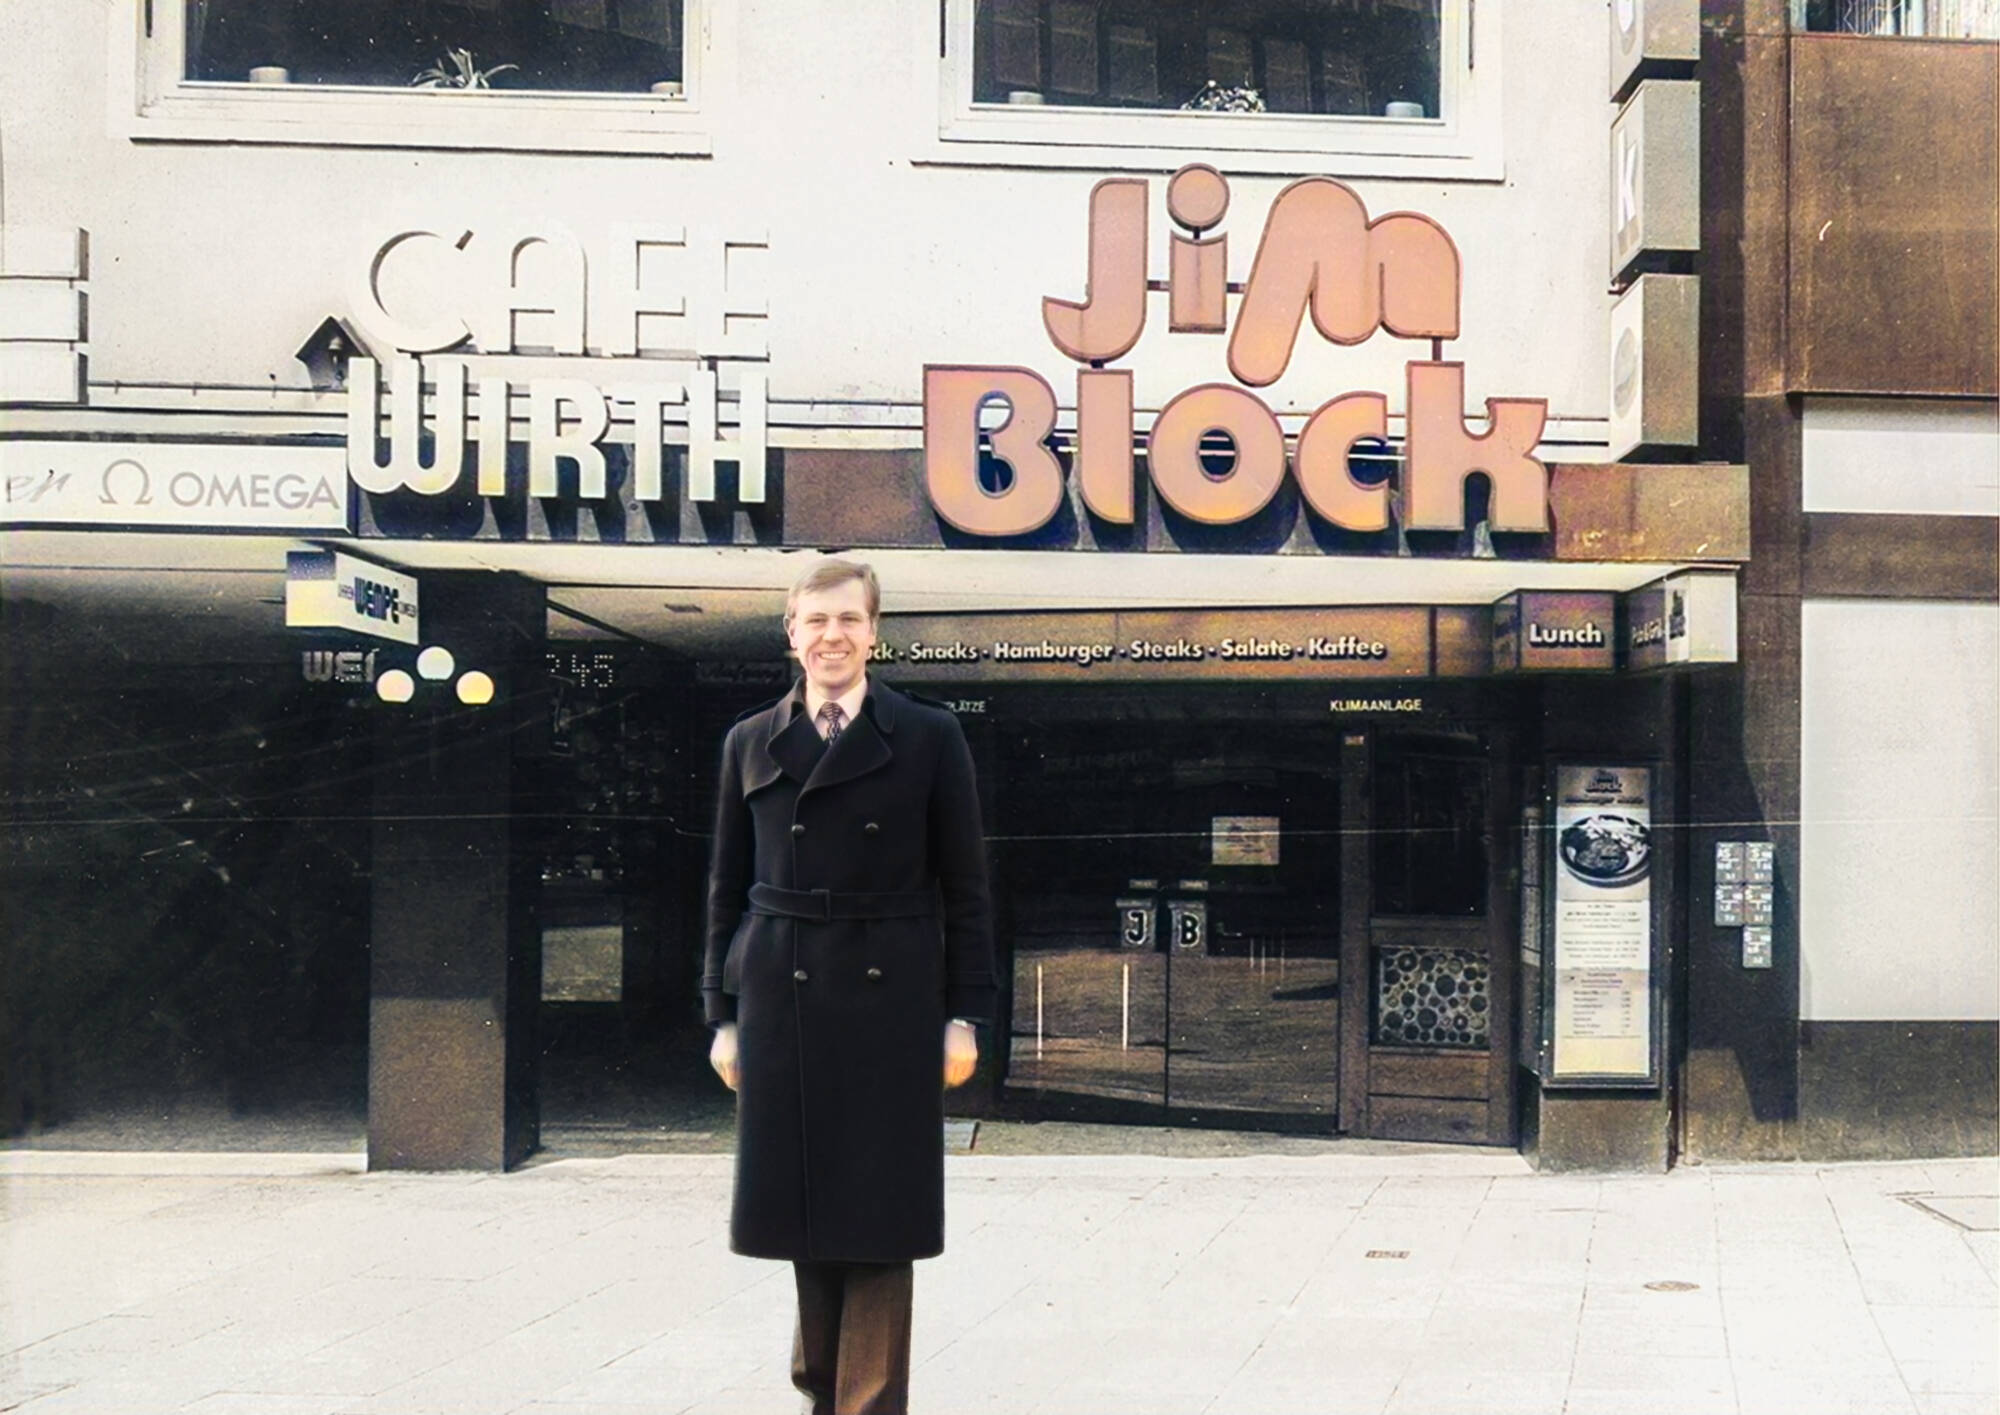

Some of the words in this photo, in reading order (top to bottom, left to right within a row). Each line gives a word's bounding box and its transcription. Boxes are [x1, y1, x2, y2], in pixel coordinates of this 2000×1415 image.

[347, 355, 768, 503] WIRTH
[169, 471, 340, 510] OMEGA
[353, 575, 400, 625] WEMPE
[910, 642, 978, 661] Snacks
[994, 642, 1113, 665] Hamburger
[1130, 640, 1203, 658] Steaks
[1220, 638, 1291, 657] Salate
[1309, 636, 1385, 657] Kaffee
[1529, 622, 1603, 646] Lunch
[1330, 699, 1422, 712] KLIMAANLAGE
[1126, 909, 1149, 945] J
[1179, 911, 1200, 948] B
